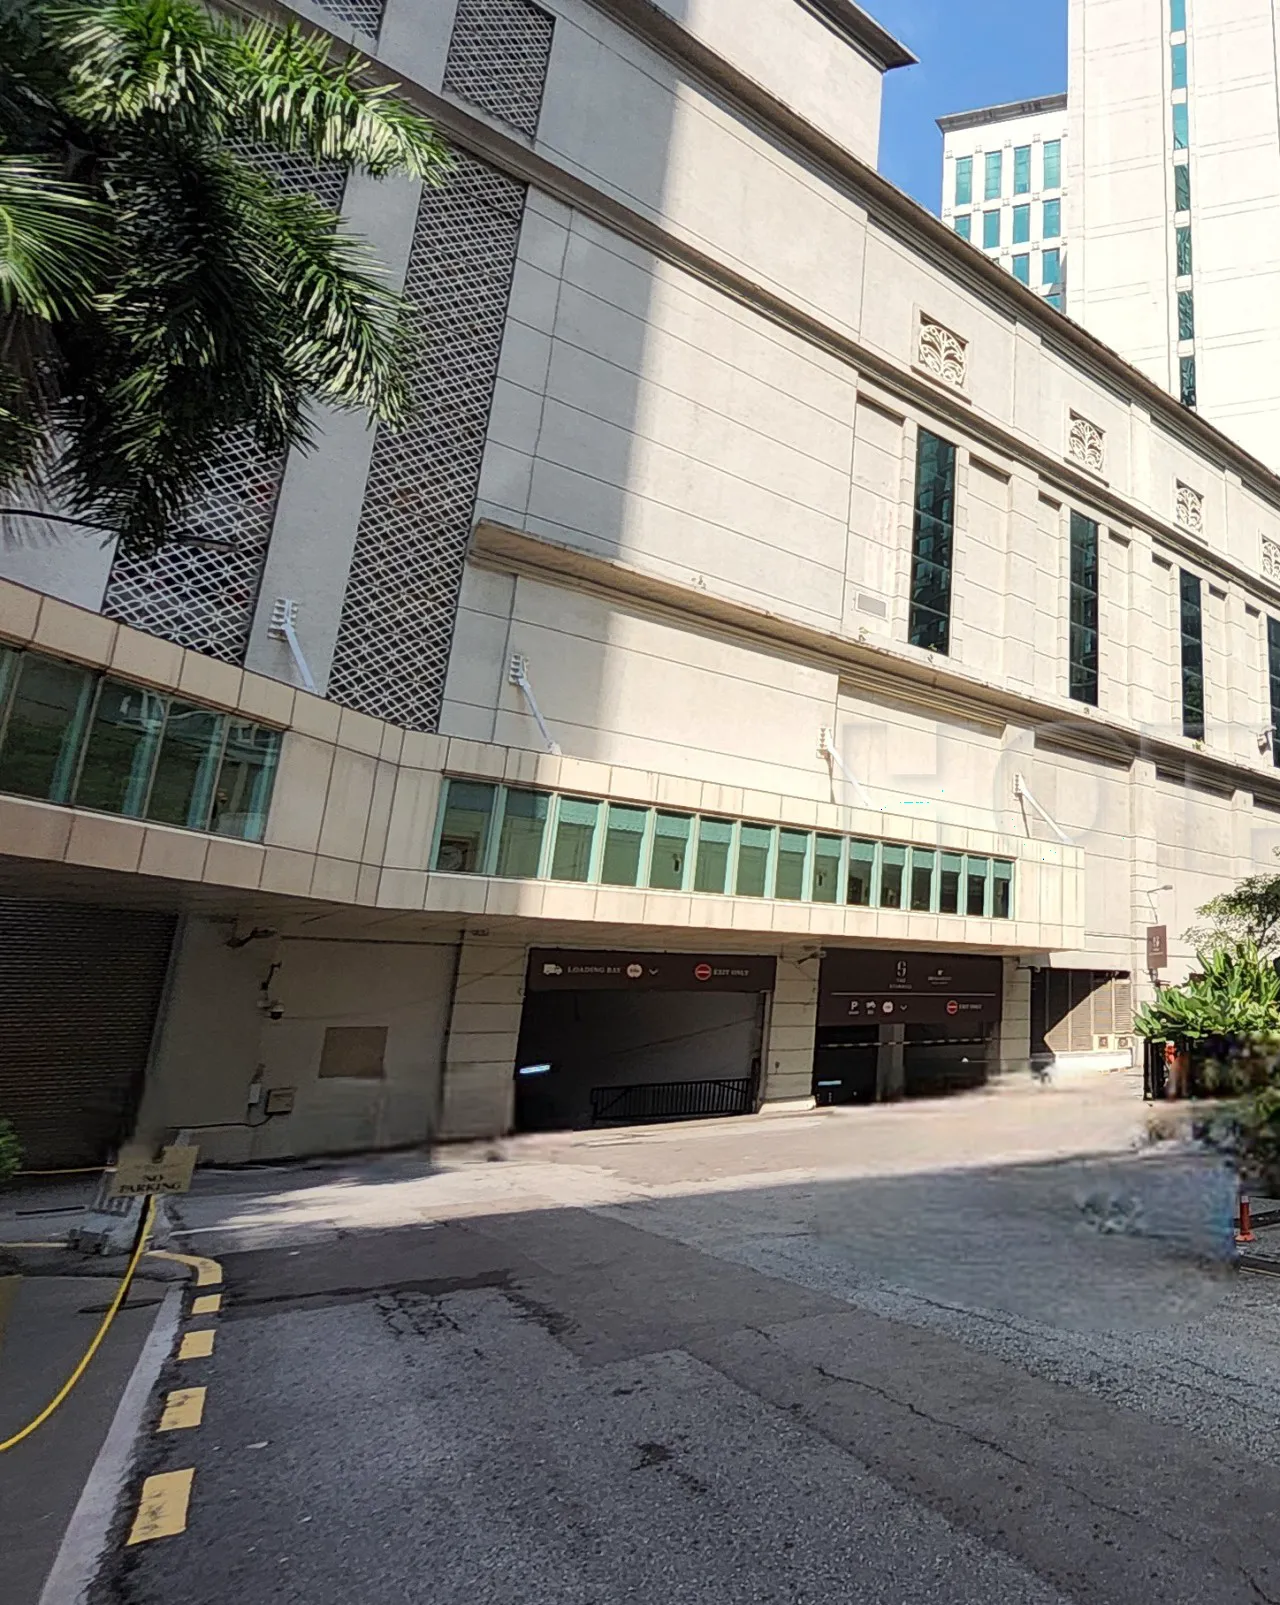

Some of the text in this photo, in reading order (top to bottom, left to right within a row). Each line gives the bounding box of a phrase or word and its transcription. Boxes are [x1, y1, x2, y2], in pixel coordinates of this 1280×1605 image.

[567, 966, 605, 974] LOADING
[713, 968, 730, 976] EXIT
[142, 1174, 164, 1182] NO
[118, 1182, 181, 1193] PARKING
